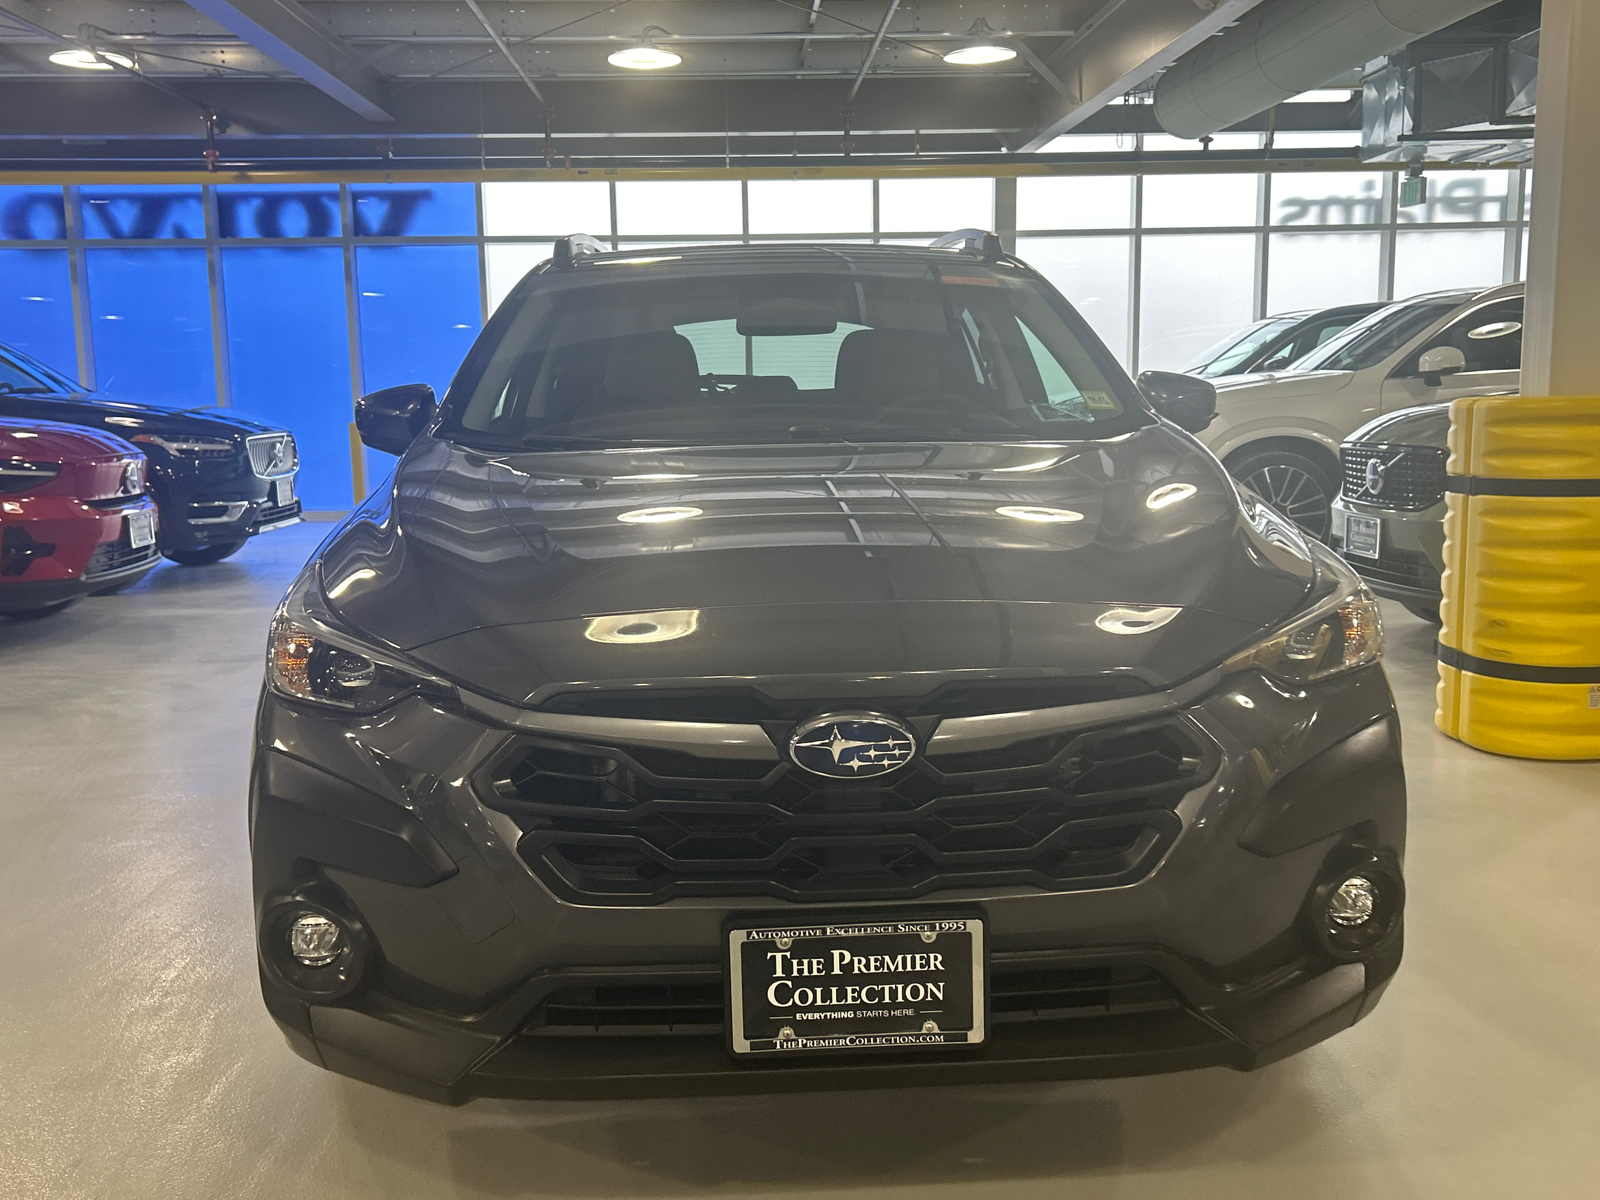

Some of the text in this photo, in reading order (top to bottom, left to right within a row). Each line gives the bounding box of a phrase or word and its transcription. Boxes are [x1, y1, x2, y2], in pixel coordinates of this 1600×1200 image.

[748, 921, 965, 940] AUTOMOTIVE EXCELLENCE SINCE 1995
[767, 949, 945, 978] THE PREMIER
[767, 980, 945, 1008] COLLECTION
[796, 1008, 917, 1020] EVERYTHING STARTS HERE.
[773, 1034, 945, 1050] THEPREMIERCOLLECTION.COM
